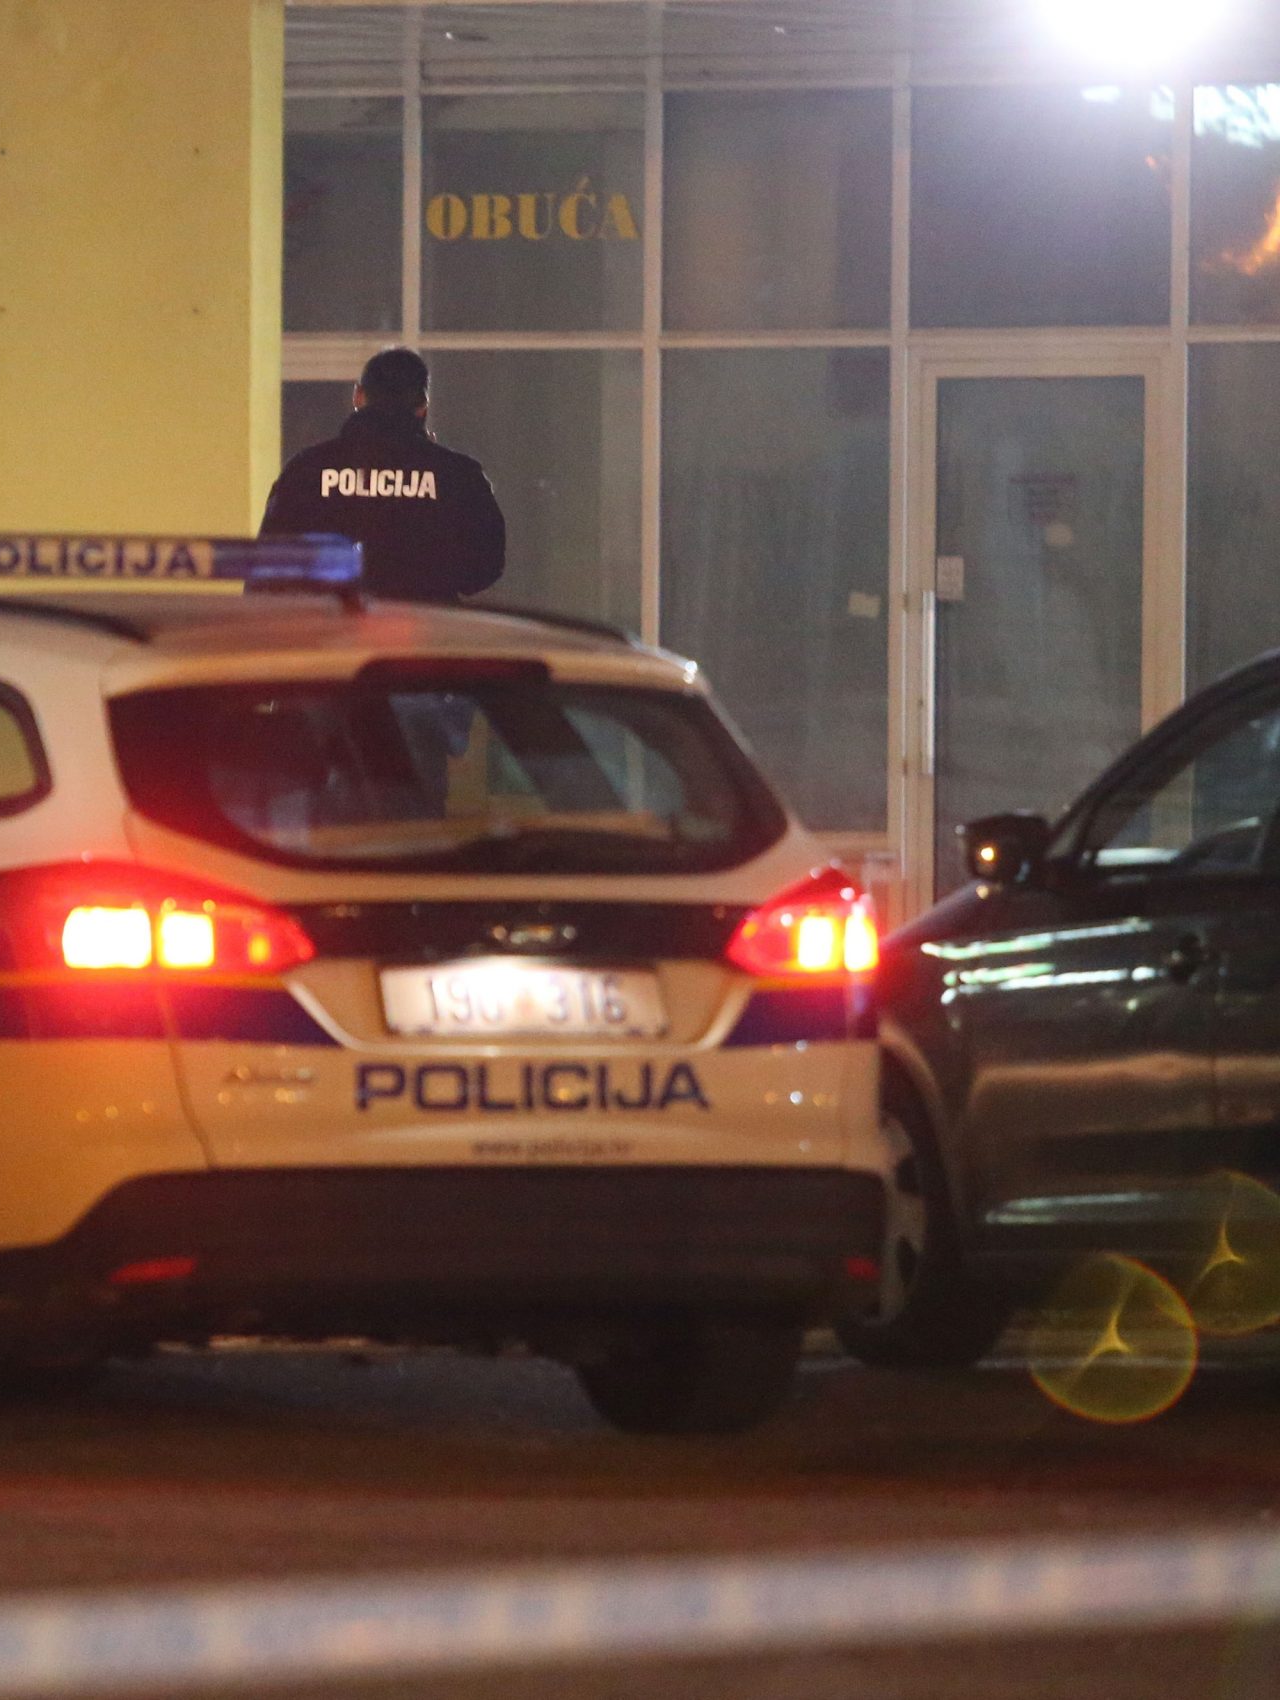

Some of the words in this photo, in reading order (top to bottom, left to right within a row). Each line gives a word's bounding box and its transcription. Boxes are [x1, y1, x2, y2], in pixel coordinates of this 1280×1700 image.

[425, 177, 639, 241] OBUĆA
[320, 468, 438, 500] POLICIJA
[354, 1061, 711, 1113] POLICIJA
